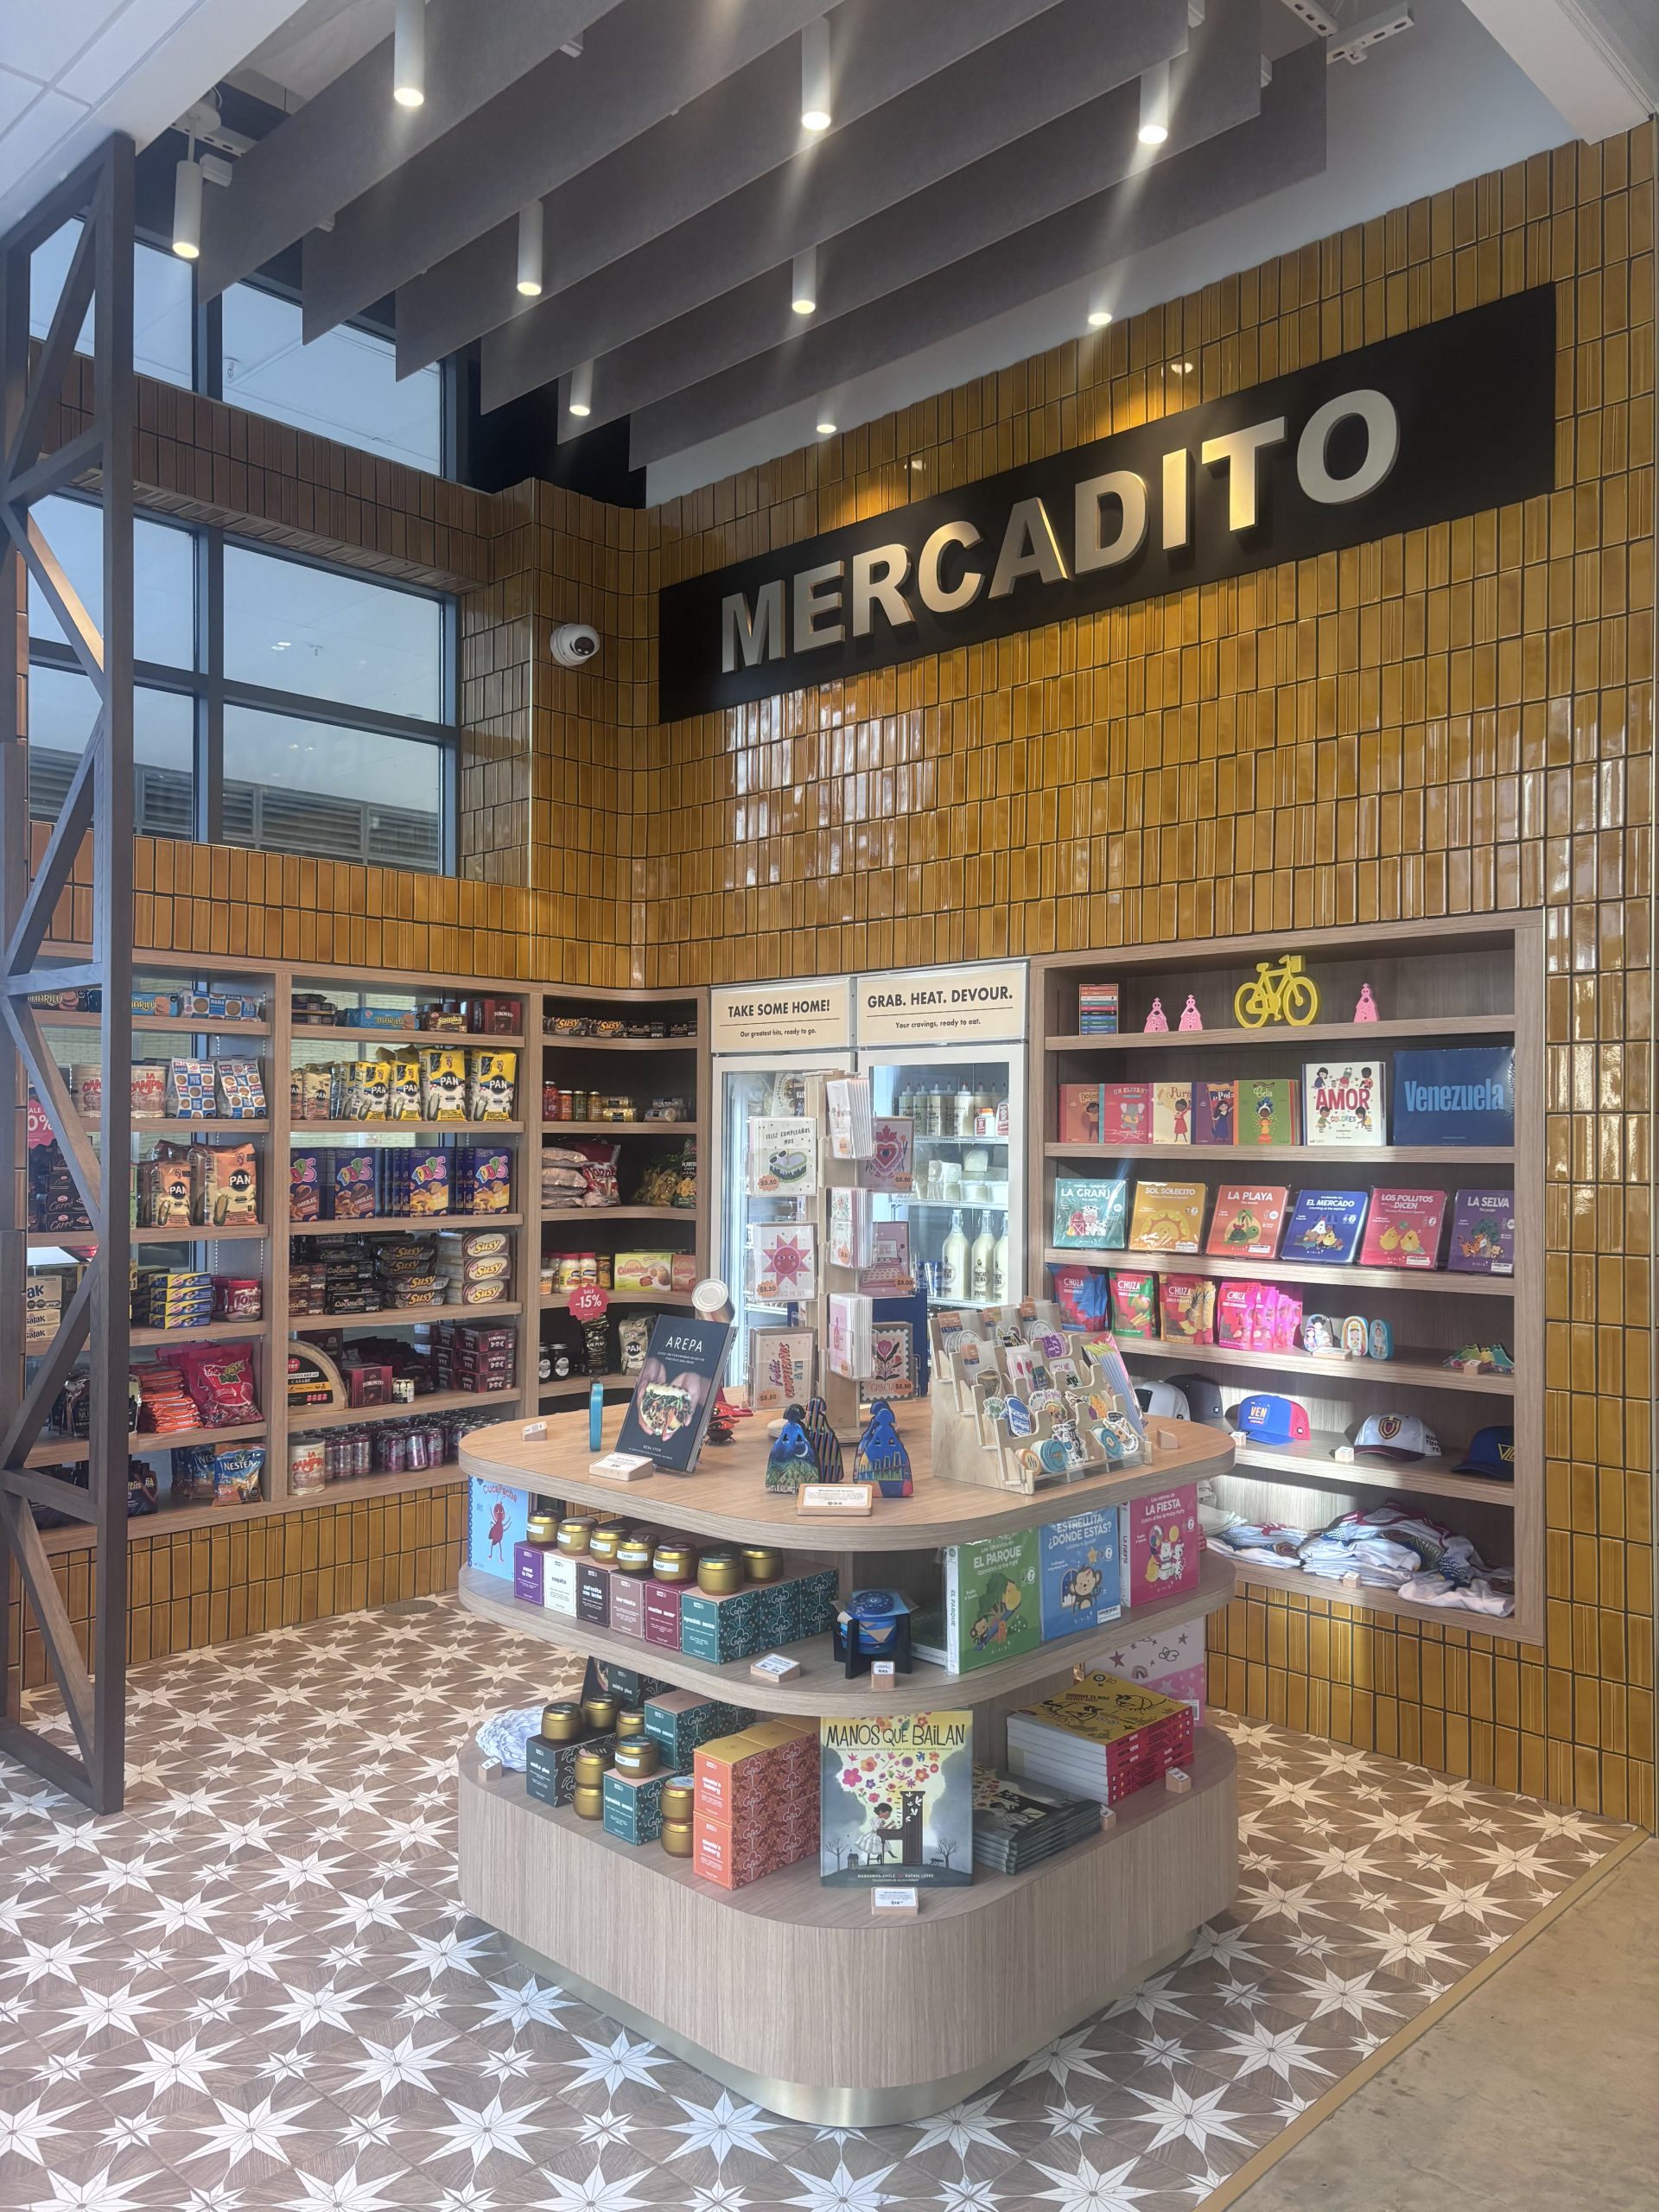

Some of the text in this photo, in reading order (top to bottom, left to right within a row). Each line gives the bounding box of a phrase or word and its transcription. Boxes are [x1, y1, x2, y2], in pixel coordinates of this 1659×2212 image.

[721, 389, 1402, 675] MERCADITO
[868, 986, 1013, 1008] GRAB. HEAT. DEVOUR.
[728, 999, 830, 1019] TAKE SOME HOME!
[438, 1016, 462, 1026] Samba
[556, 1017, 580, 1030] Susy
[600, 1020, 621, 1032] Susy
[911, 1020, 938, 1030] cravings,
[940, 1019, 958, 1028] ready
[751, 1029, 772, 1039] greatest
[772, 1028, 783, 1038] hits,
[784, 1028, 799, 1038] ready
[440, 1076, 459, 1086] PAN
[489, 1080, 508, 1090] PAN
[1315, 1088, 1370, 1111] AMOR
[1404, 1077, 1504, 1113] Venezuela
[229, 1175, 251, 1185] PAN
[1061, 1188, 1074, 1197] LA
[1228, 1191, 1273, 1201] LA PLAYA
[1396, 1194, 1434, 1203] POLLITOS
[1467, 1196, 1510, 1208] LA SELVA
[474, 1240, 501, 1255] Susy
[475, 1263, 502, 1278] Susy
[410, 1275, 436, 1289] Susy
[1064, 1277, 1084, 1287] CHUZA
[1117, 1280, 1141, 1290] CHUZA
[474, 1286, 499, 1301] Susy
[1168, 1286, 1191, 1296] CHUZA
[1227, 1291, 1246, 1300] CHUZA
[408, 1292, 435, 1306] Susy
[575, 1294, 602, 1308] -15%
[664, 1336, 702, 1353] AREPA
[871, 1382, 896, 1392] GRACIA
[1250, 1406, 1268, 1418] VEN
[223, 1460, 255, 1471] NESTEA
[1145, 1498, 1181, 1516] LA FIESTA
[973, 1546, 1022, 1569] EL PARQUE
[826, 1724, 880, 1747] MANOS
[882, 1727, 908, 1746] QUE
